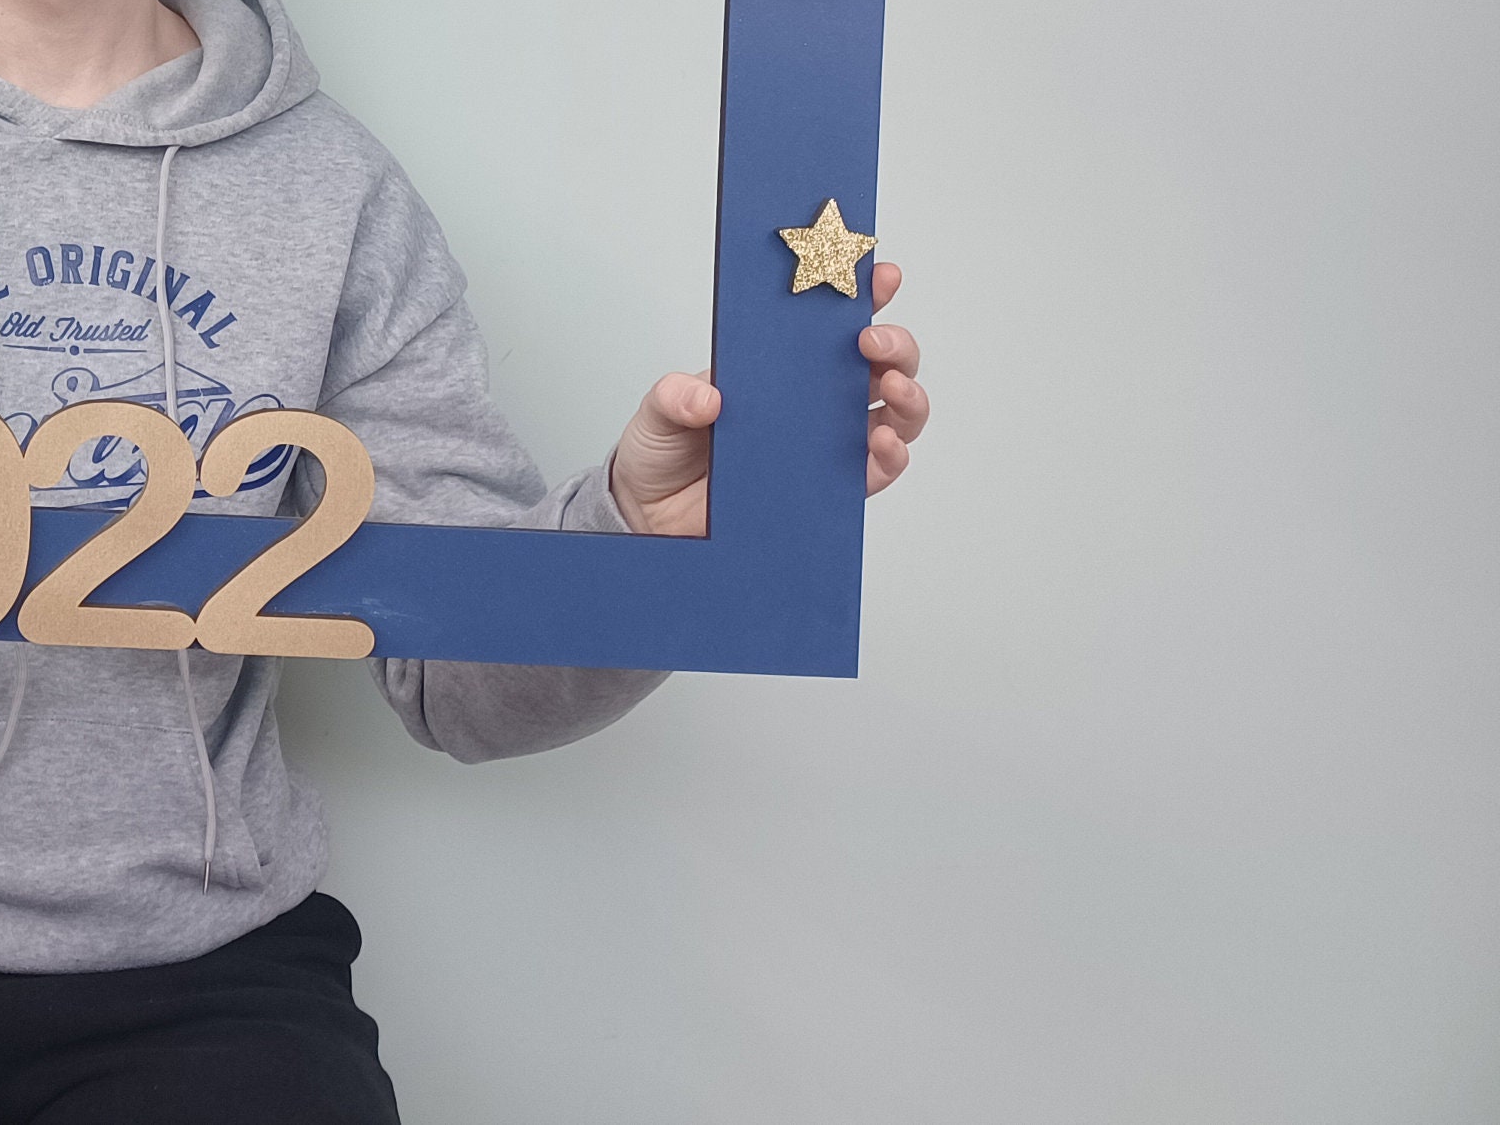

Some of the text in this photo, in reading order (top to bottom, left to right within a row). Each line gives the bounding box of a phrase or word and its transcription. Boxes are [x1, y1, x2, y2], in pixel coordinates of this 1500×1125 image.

[0, 310, 152, 342] Old Trusted
[25, 243, 238, 349] ORIGINAL
